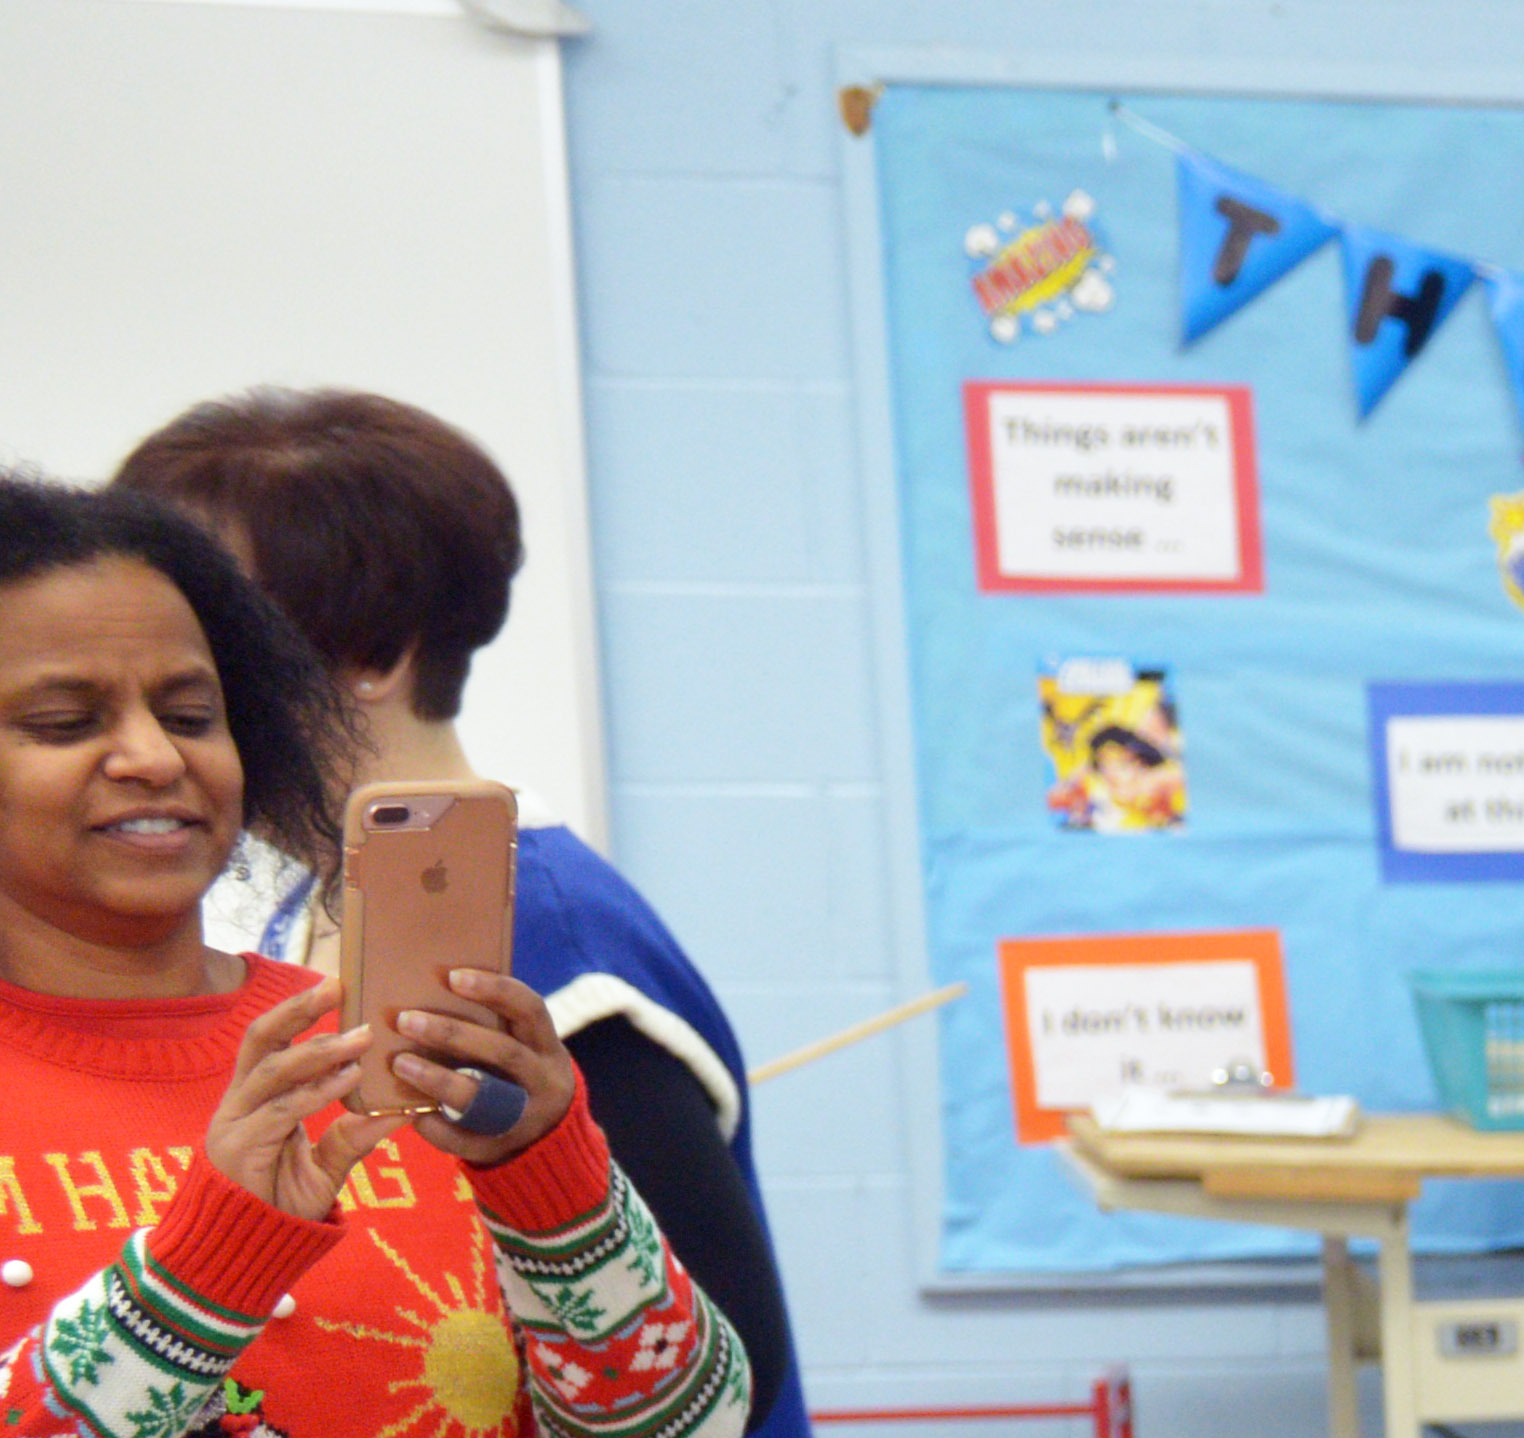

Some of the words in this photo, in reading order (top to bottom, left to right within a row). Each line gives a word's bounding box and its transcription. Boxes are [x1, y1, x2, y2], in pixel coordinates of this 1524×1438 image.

[1002, 415, 1111, 453] Things
[1119, 416, 1221, 448] aren't
[1053, 466, 1176, 504] making
[1053, 527, 1146, 549] sense
[1420, 754, 1467, 775] am
[1446, 800, 1475, 823] at
[1062, 1005, 1150, 1035] don't
[1157, 1003, 1245, 1032] know
